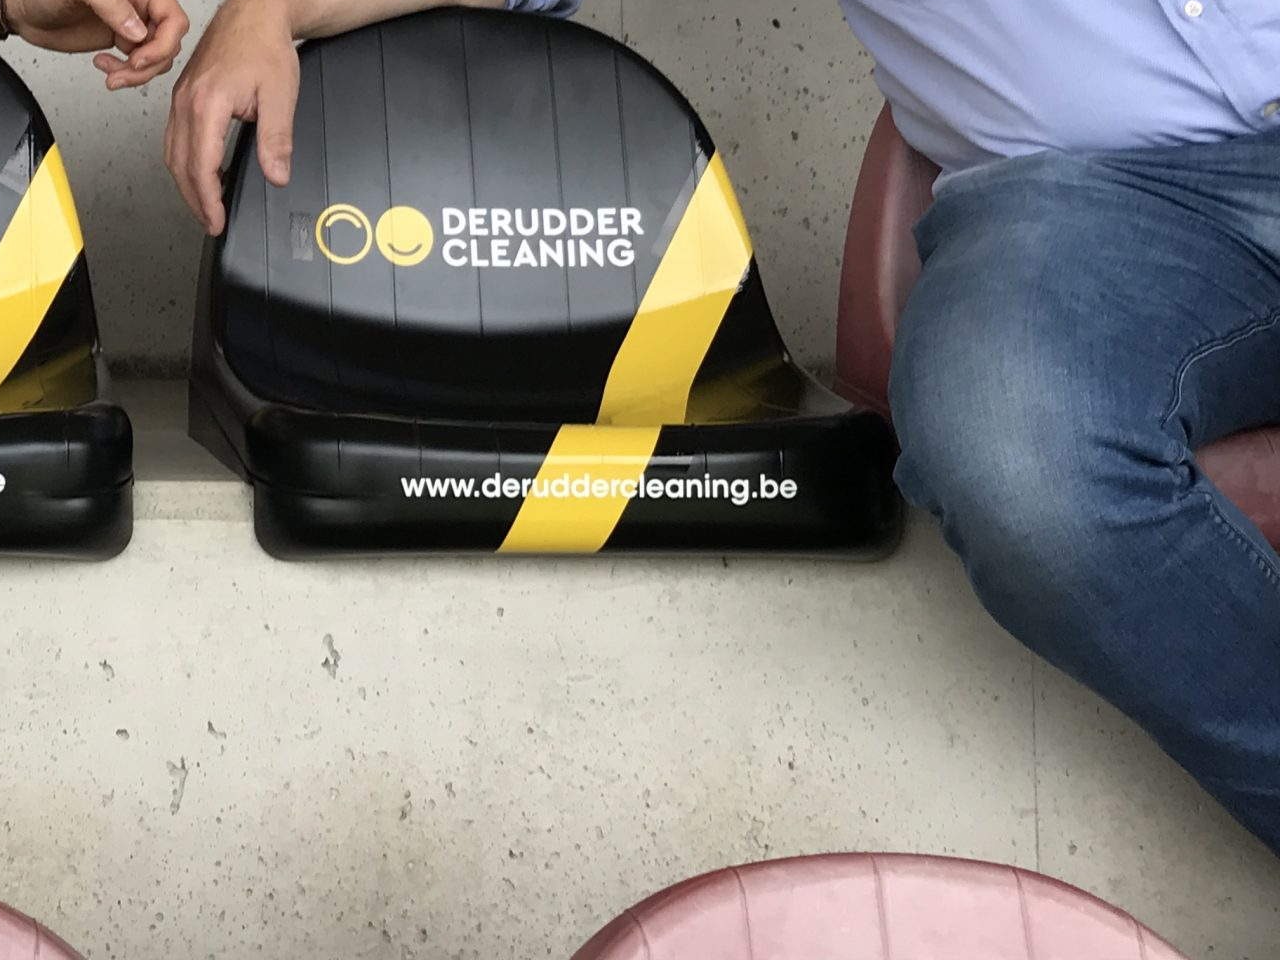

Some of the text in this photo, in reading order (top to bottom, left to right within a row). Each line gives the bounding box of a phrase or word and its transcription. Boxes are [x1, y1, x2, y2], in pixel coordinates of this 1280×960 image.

[441, 206, 645, 237] DERUDDER
[441, 237, 636, 268] CLEANING
[400, 472, 799, 505] www.deruddercleaning.be
